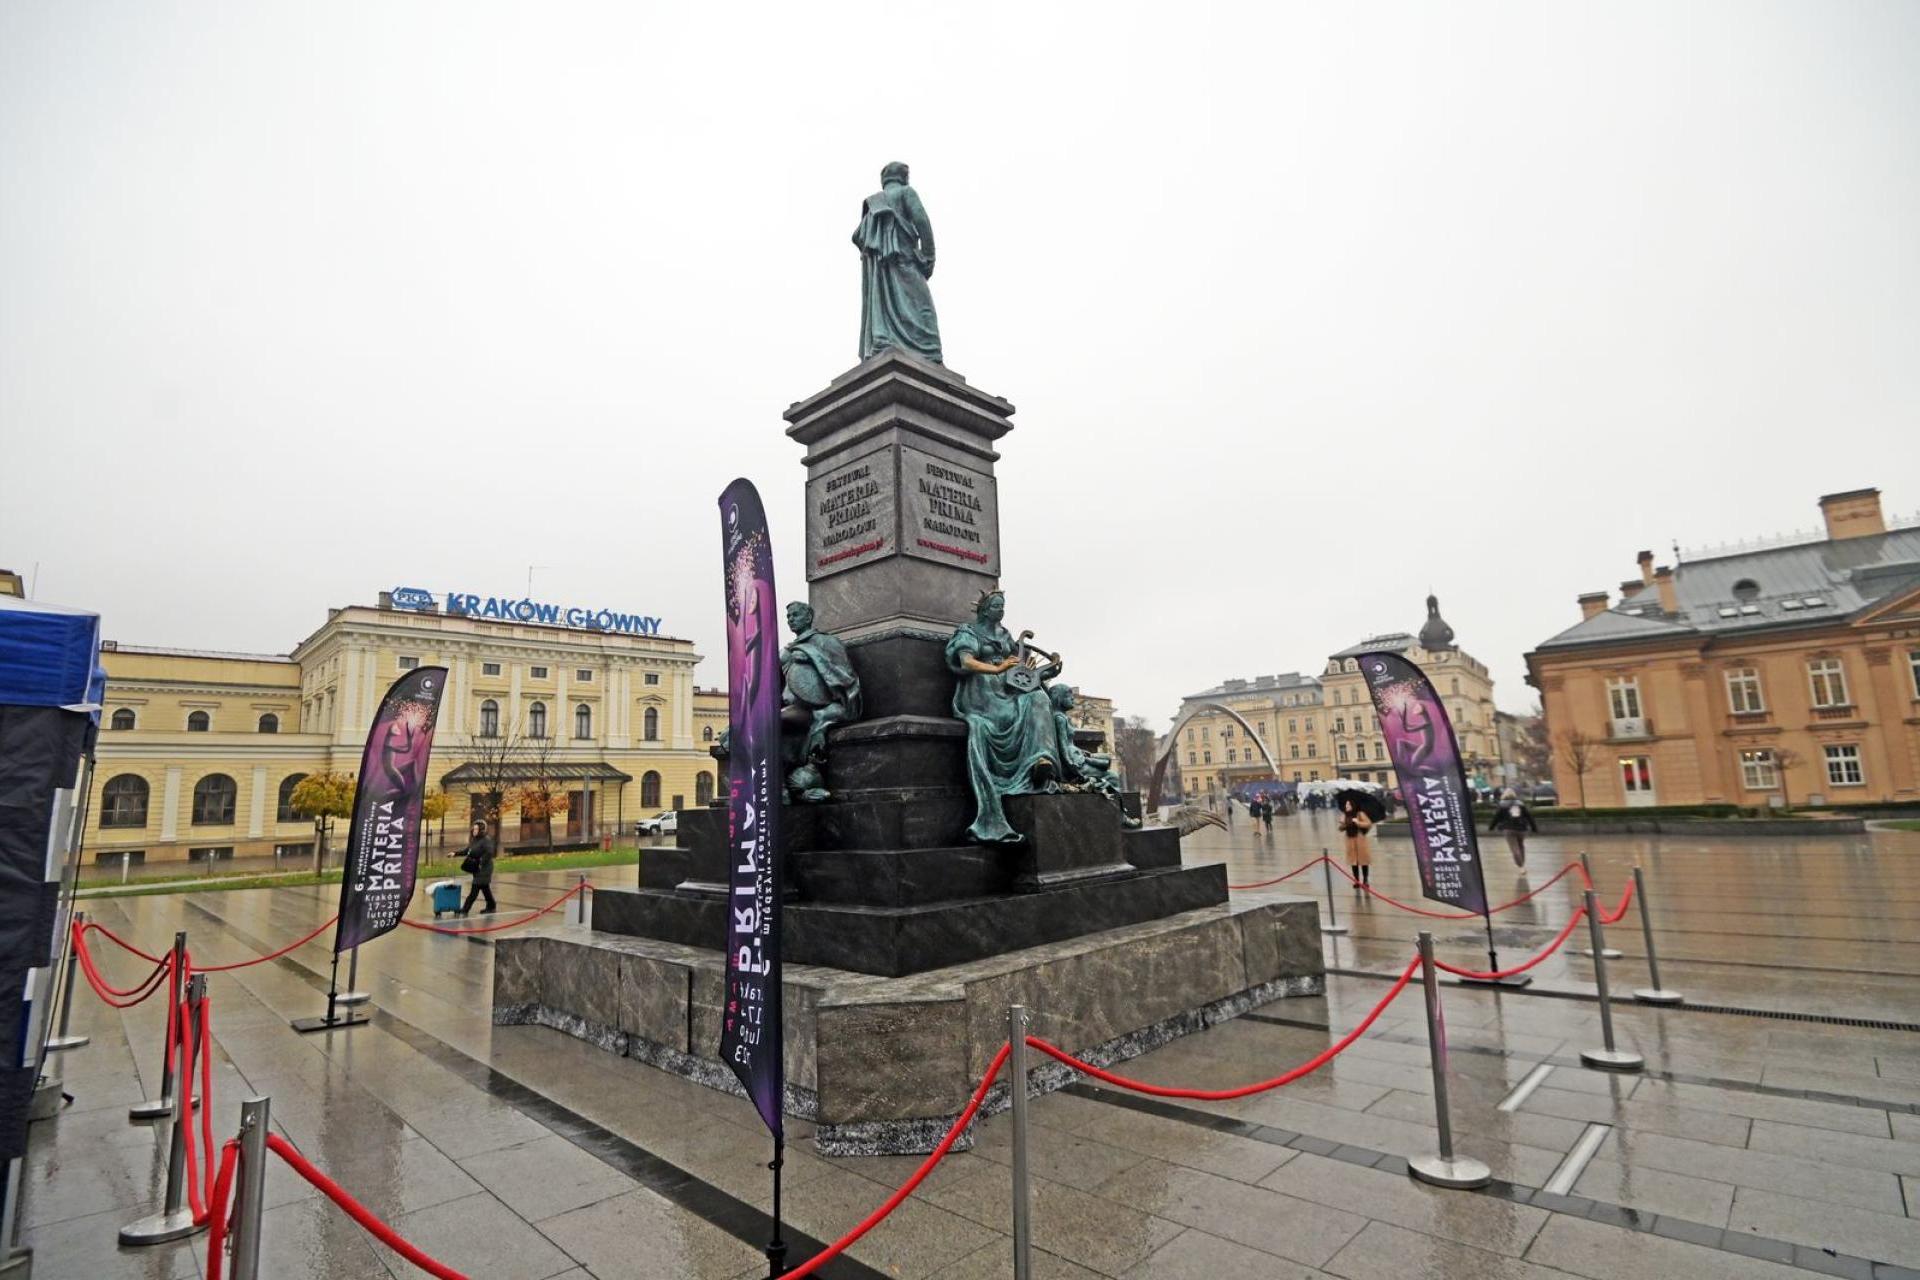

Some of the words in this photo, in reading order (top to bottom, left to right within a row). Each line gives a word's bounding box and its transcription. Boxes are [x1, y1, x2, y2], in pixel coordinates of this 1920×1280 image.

[819, 479, 879, 515] MATERIA
[918, 478, 983, 512] MATERIA
[929, 498, 976, 525] PRIMA
[828, 502, 871, 528] PRIMA
[446, 592, 560, 623] KRAKÓW
[566, 607, 662, 635] GŁÓWNY
[366, 801, 395, 892] MATERIA
[383, 816, 405, 890] PRIMA
[365, 893, 401, 902] Kraków
